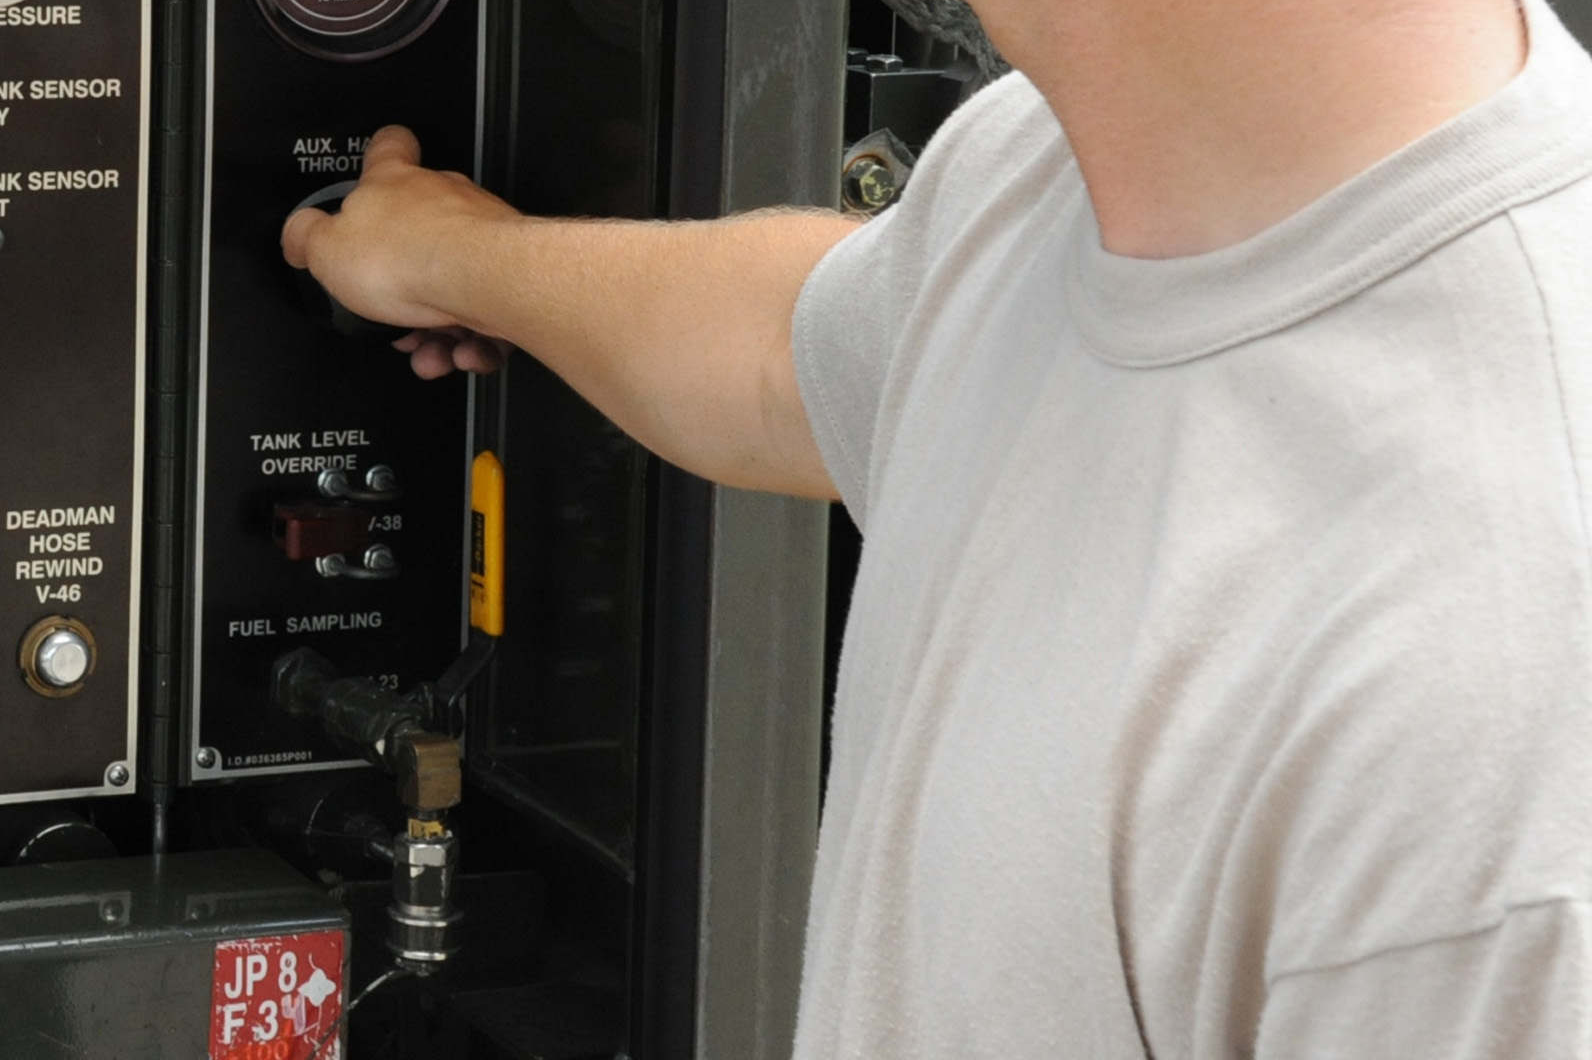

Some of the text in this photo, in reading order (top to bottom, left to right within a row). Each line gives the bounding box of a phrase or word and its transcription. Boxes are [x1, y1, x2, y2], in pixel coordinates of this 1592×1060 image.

[30, 79, 120, 99] SENSOR
[293, 138, 337, 155] AUX.
[297, 157, 363, 173] THROT
[28, 170, 118, 190] SENSOR
[251, 430, 369, 450] TANK LEVEL
[262, 454, 357, 476] OVERRIDE
[7, 506, 114, 529] DEADMAN
[30, 532, 90, 553] HOSE
[16, 557, 102, 579] REWIND
[36, 584, 81, 603] V-46
[229, 612, 381, 637] FUEL SAMPLING
[224, 951, 297, 999] JP 8
[223, 1002, 247, 1044] F
